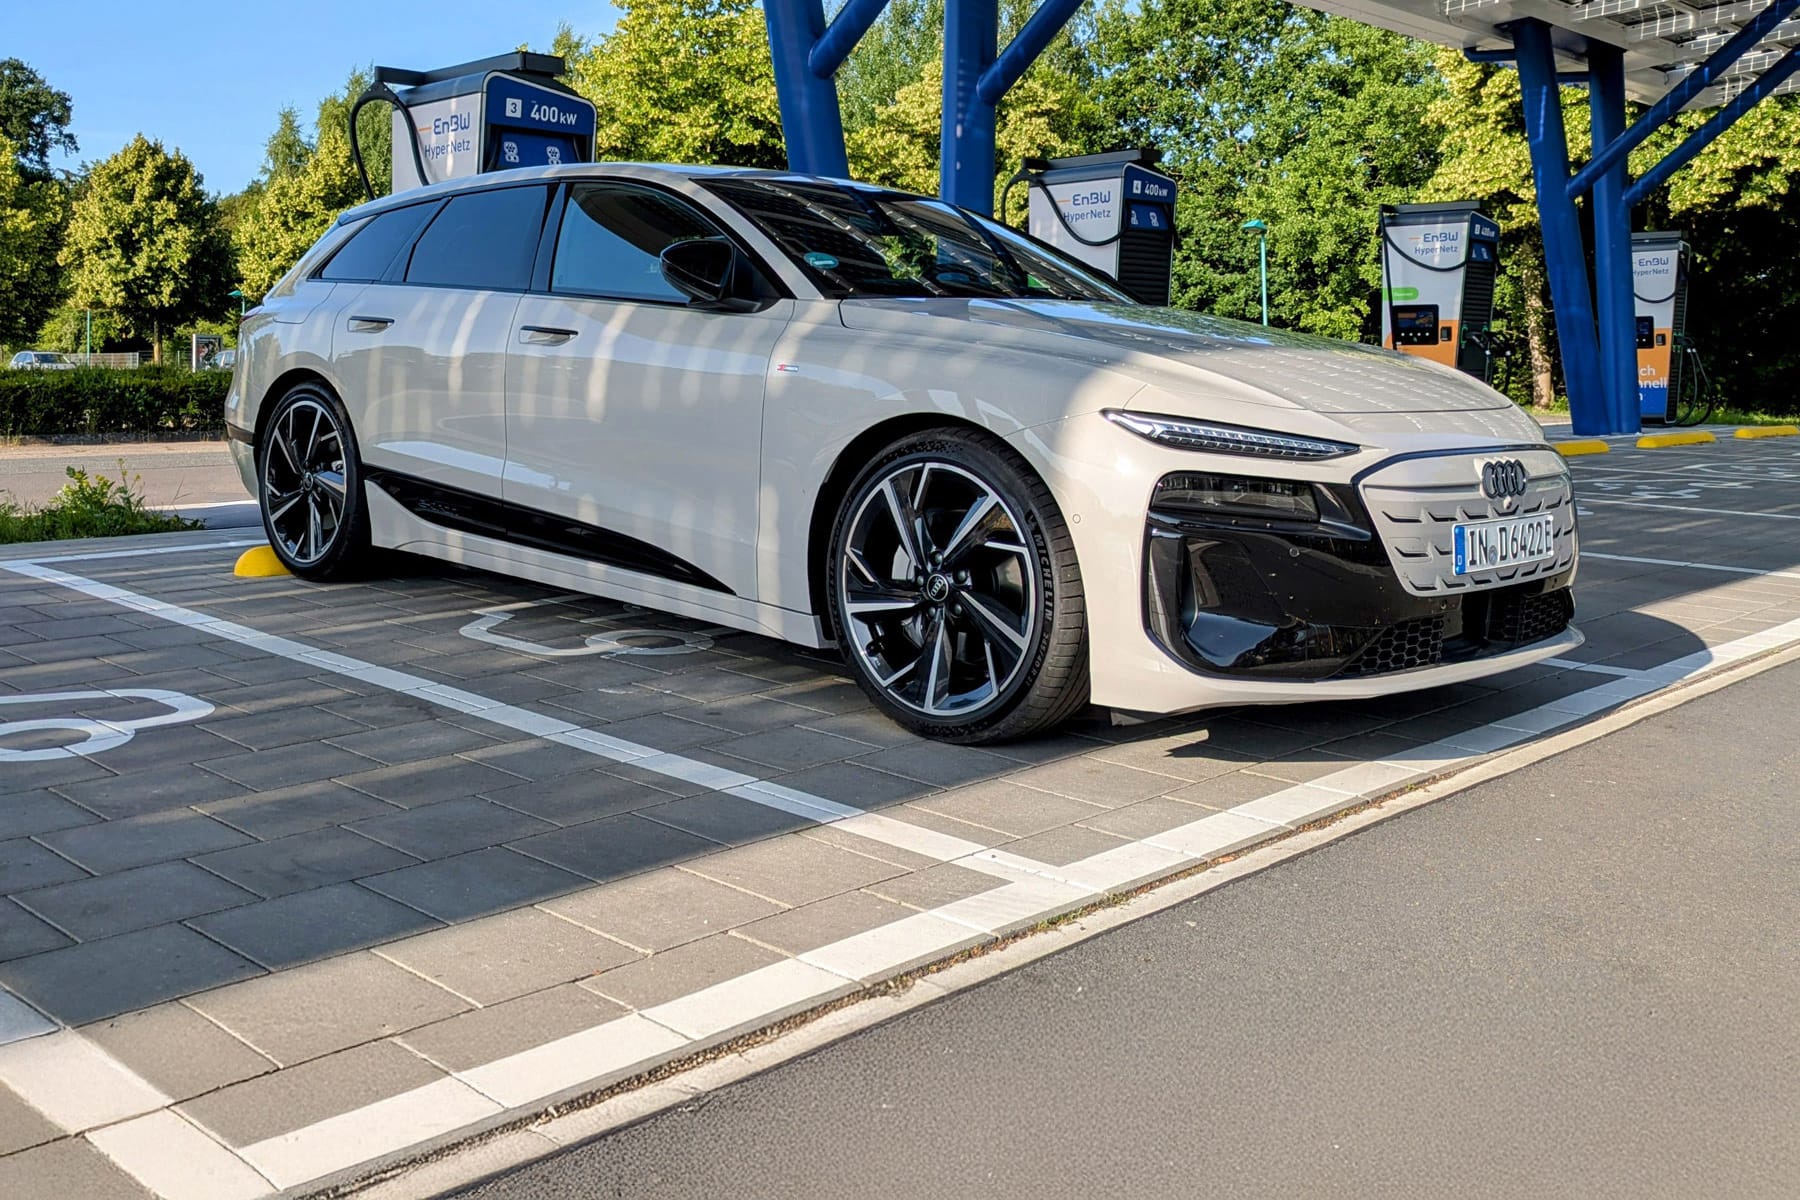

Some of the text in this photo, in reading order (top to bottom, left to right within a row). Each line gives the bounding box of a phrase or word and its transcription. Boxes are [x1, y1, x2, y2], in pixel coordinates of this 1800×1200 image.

[510, 102, 517, 114] 3
[530, 104, 577, 125] 400 kW
[433, 111, 470, 135] EnBW
[1072, 191, 1111, 206] EnBW
[1063, 209, 1111, 223] HyperNetz
[1423, 231, 1458, 243] EnBW
[1638, 257, 1669, 267] EnBW
[1639, 364, 1656, 376] ch
[1469, 530, 1488, 566] IN
[1457, 555, 1462, 565] D
[1033, 533, 1053, 622] MICHELIN
